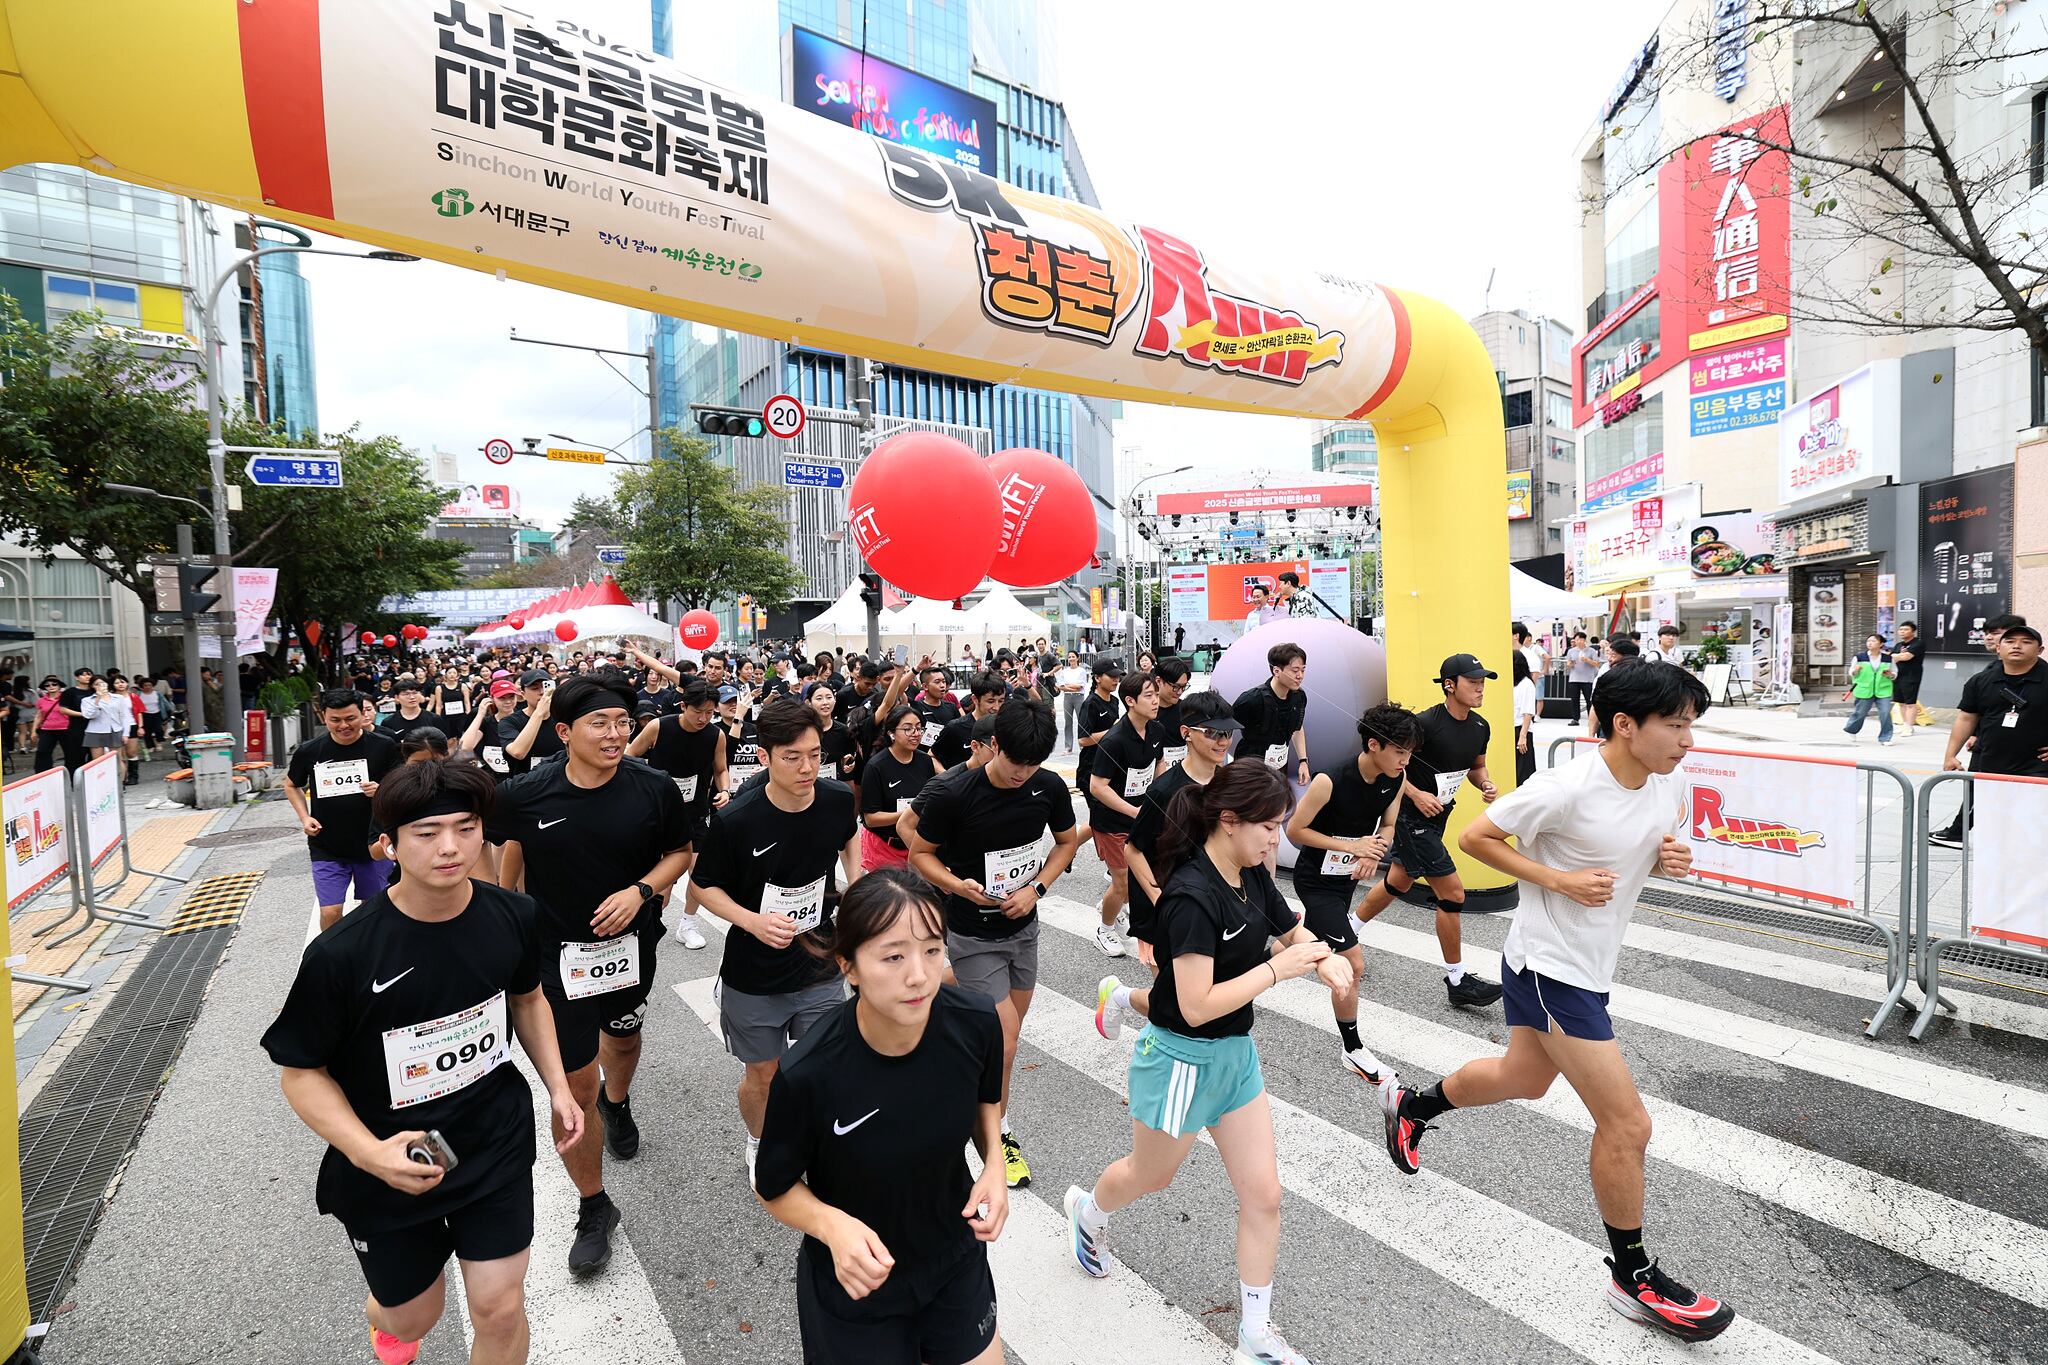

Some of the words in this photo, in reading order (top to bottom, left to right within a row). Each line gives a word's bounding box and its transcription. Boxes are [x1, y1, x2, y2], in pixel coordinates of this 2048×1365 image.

[433, 0, 768, 154] 신촌글로벌
[434, 55, 769, 205] 대학문화축제
[955, 148, 980, 167] 2025
[437, 142, 537, 183] Sinchon
[543, 169, 613, 202] World
[619, 189, 680, 221] Youth
[686, 207, 765, 241] FesTival
[881, 142, 1029, 227] 5K
[479, 200, 571, 237] 서대문구
[1709, 127, 1760, 301] 華人通信
[598, 230, 628, 250] 당신
[632, 239, 657, 253] 곁에
[661, 247, 736, 276] 계속운전
[981, 225, 1118, 337] 청춘
[1212, 341, 1237, 354] 연세로
[1246, 336, 1284, 352] 안산자락길
[1285, 334, 1313, 346] 순환코스
[1692, 369, 1708, 387] 썸
[1694, 387, 1783, 419] 믿음부동산
[773, 408, 797, 427] 20
[491, 446, 508, 458] 20
[551, 451, 601, 462] 신호과속단속장비
[292, 462, 337, 476] 명물길
[787, 464, 829, 478] 연세로5길
[1791, 449, 1857, 487] 코인노래연습장
[279, 476, 338, 484] Myeongmul-gil
[787, 476, 814, 485] Yonsei-ro
[1204, 499, 1227, 508] 2025
[1016, 520, 1027, 537] World
[1023, 504, 1034, 520] Youth
[1601, 527, 1650, 561] 구포국수
[1672, 546, 1687, 560] 우동
[1958, 554, 1969, 565] 2
[1244, 577, 1259, 585] 5K
[1958, 570, 1969, 580] 3
[1958, 585, 1969, 595] 4
[684, 625, 707, 635] SWYFT
[734, 755, 755, 763] TEAMS
[335, 774, 362, 786] 043
[1692, 786, 1800, 853] Run
[5, 819, 19, 844] 5K
[1009, 860, 1036, 879] 073
[787, 902, 817, 920] 084
[590, 958, 629, 978] 092
[440, 1025, 478, 1043] 계속운전
[436, 1032, 495, 1072] 090
